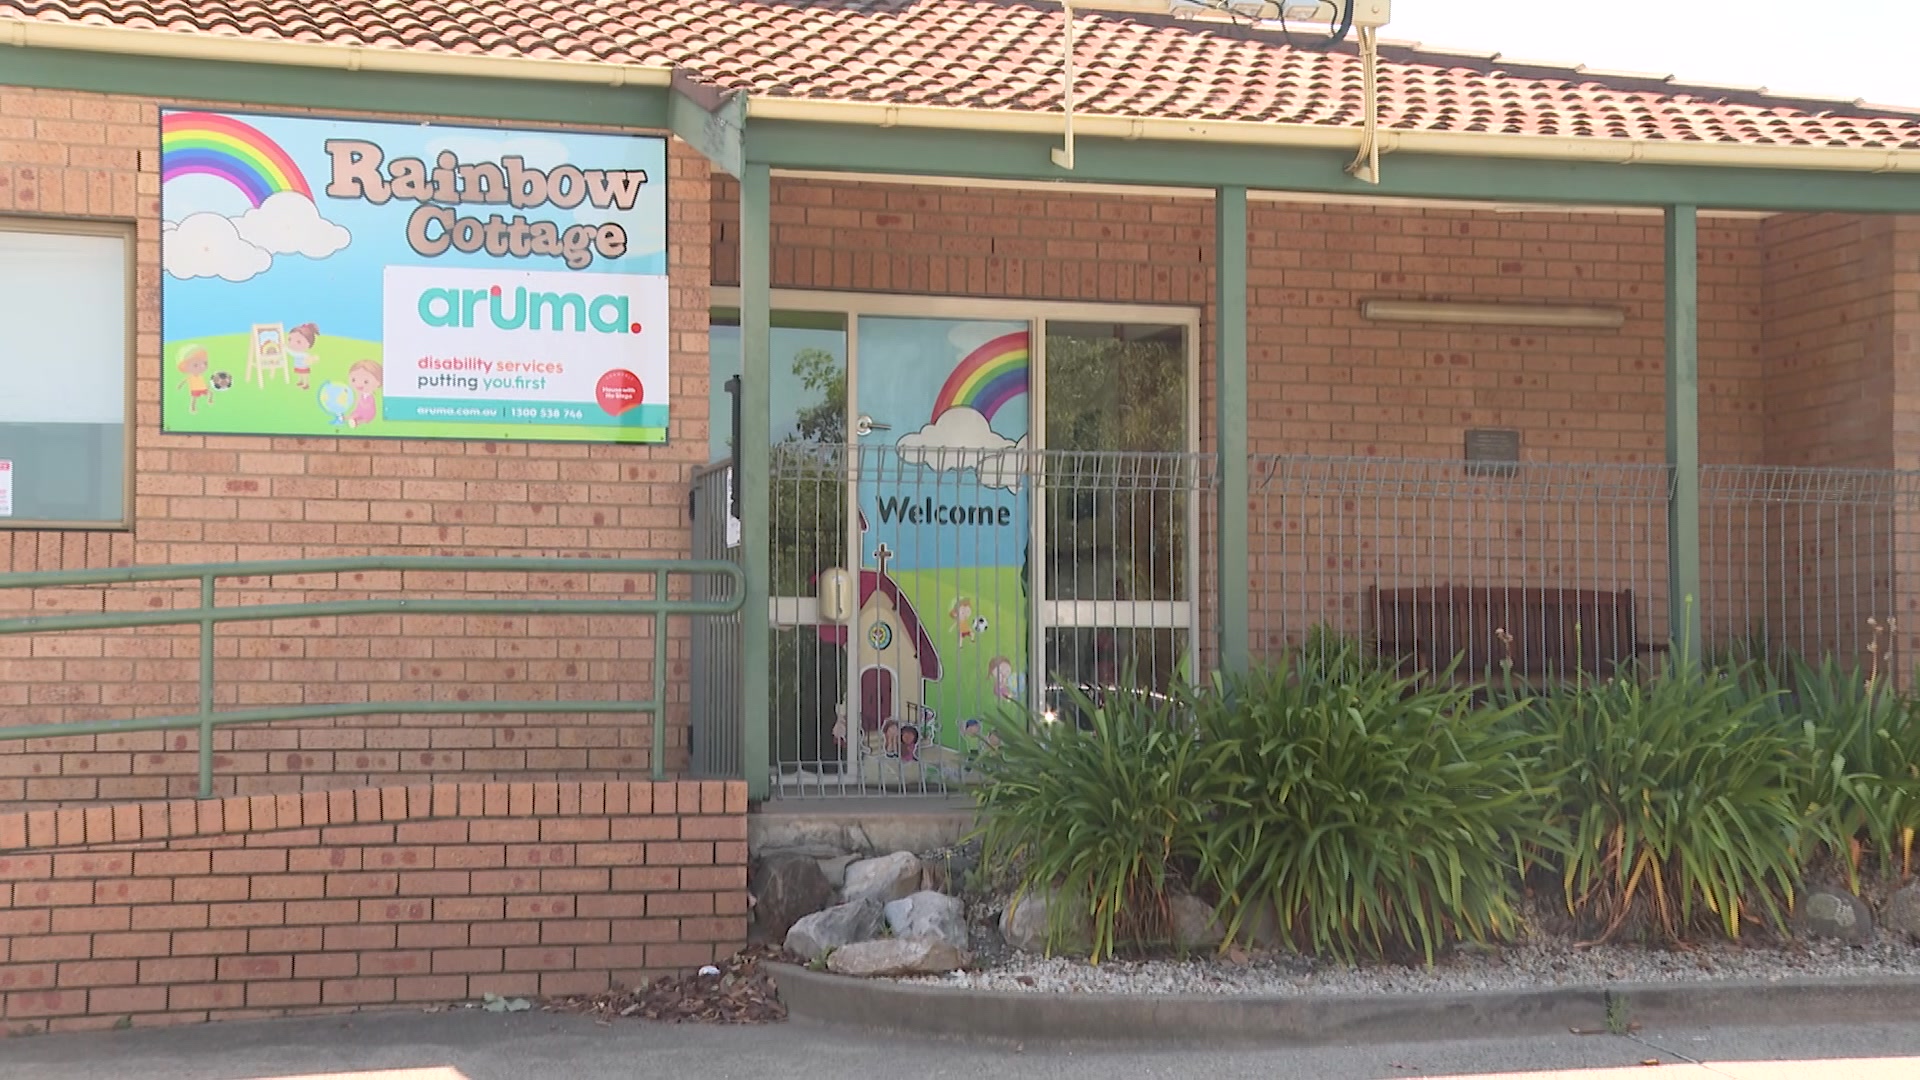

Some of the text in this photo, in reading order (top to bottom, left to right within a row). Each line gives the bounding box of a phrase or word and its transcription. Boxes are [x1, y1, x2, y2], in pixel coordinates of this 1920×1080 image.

[325, 139, 647, 210] Rainbow
[406, 204, 627, 270] Cottage
[418, 356, 564, 374] disability services
[417, 374, 478, 391] putting
[416, 406, 497, 417] aruma.com.au
[511, 407, 537, 418] 1300
[876, 495, 1011, 526] Welcome
